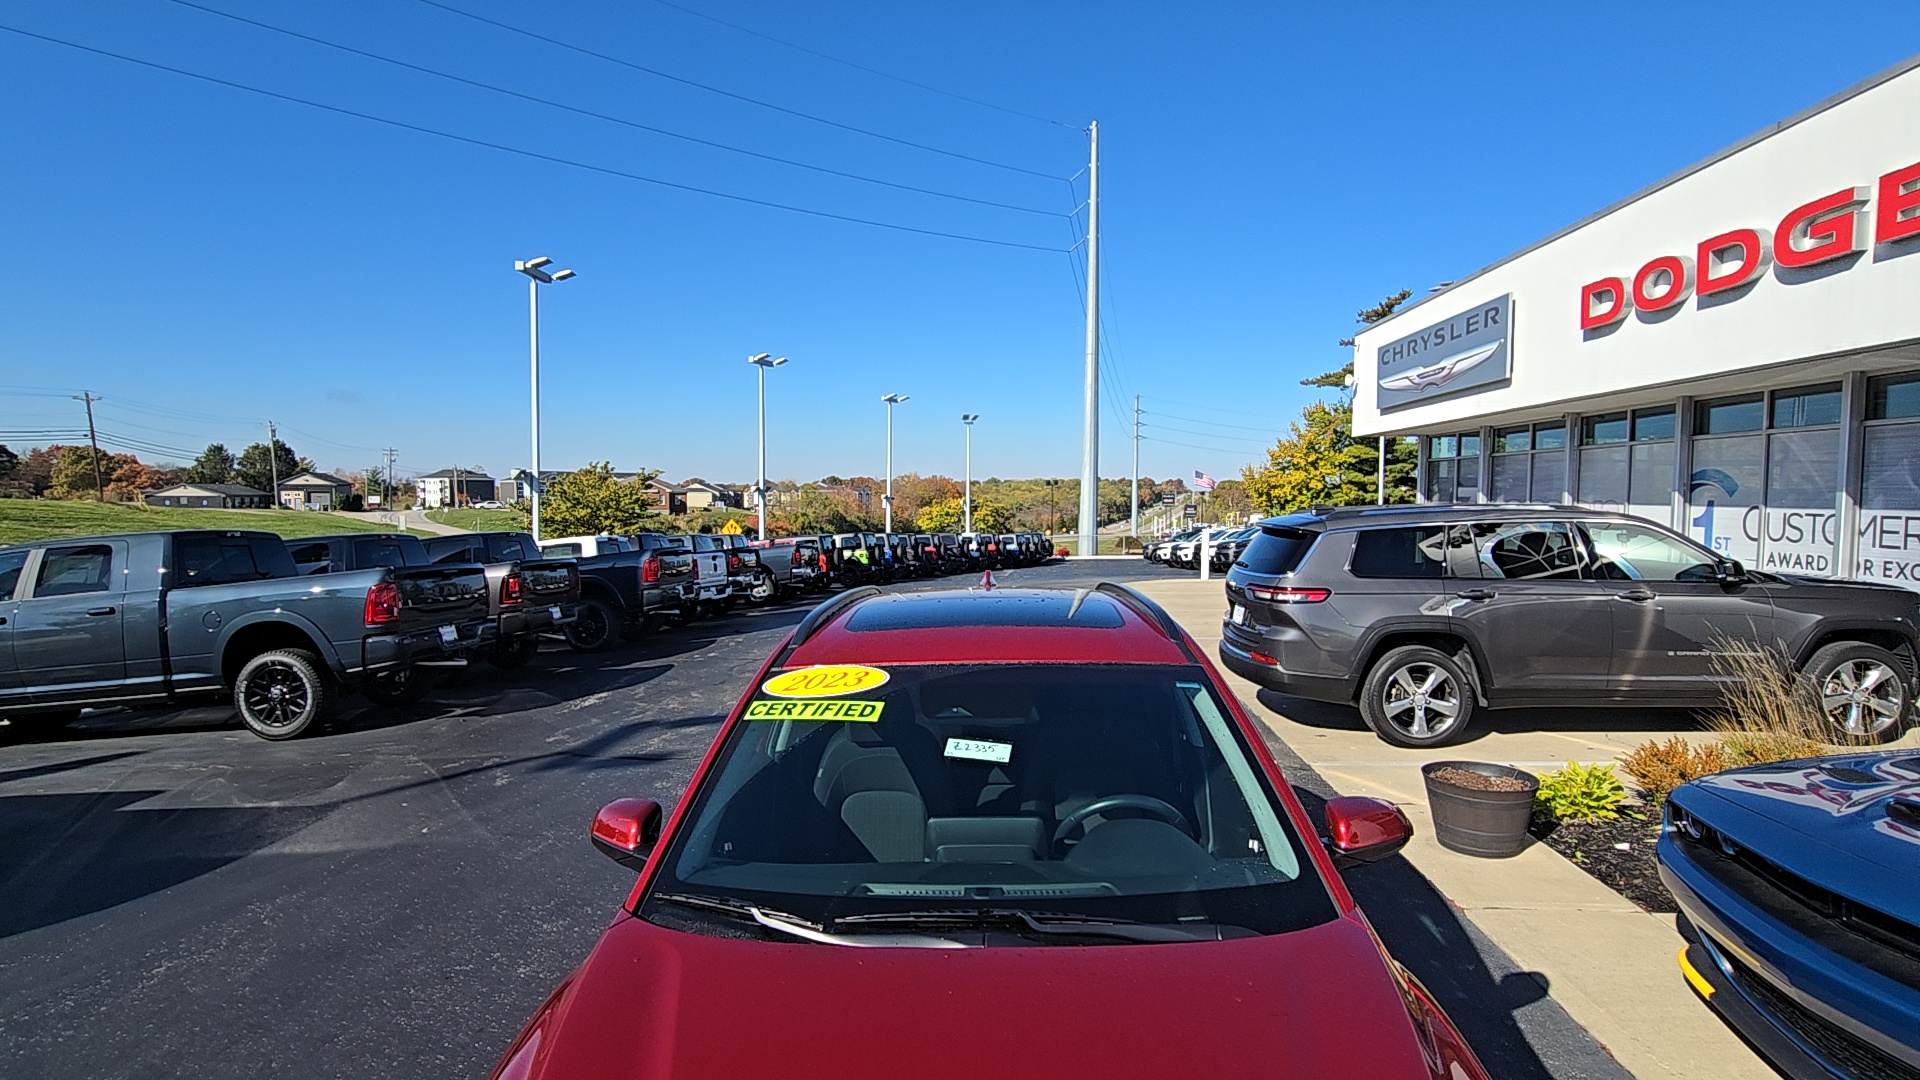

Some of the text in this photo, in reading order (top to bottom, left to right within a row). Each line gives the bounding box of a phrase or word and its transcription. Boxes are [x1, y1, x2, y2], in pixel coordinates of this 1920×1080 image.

[1580, 161, 1920, 330] DODGE
[1381, 306, 1500, 365] CHRYSLER
[1766, 552, 1829, 572] AWARD
[781, 671, 870, 692] 2023
[749, 702, 877, 718] CERTIFIED
